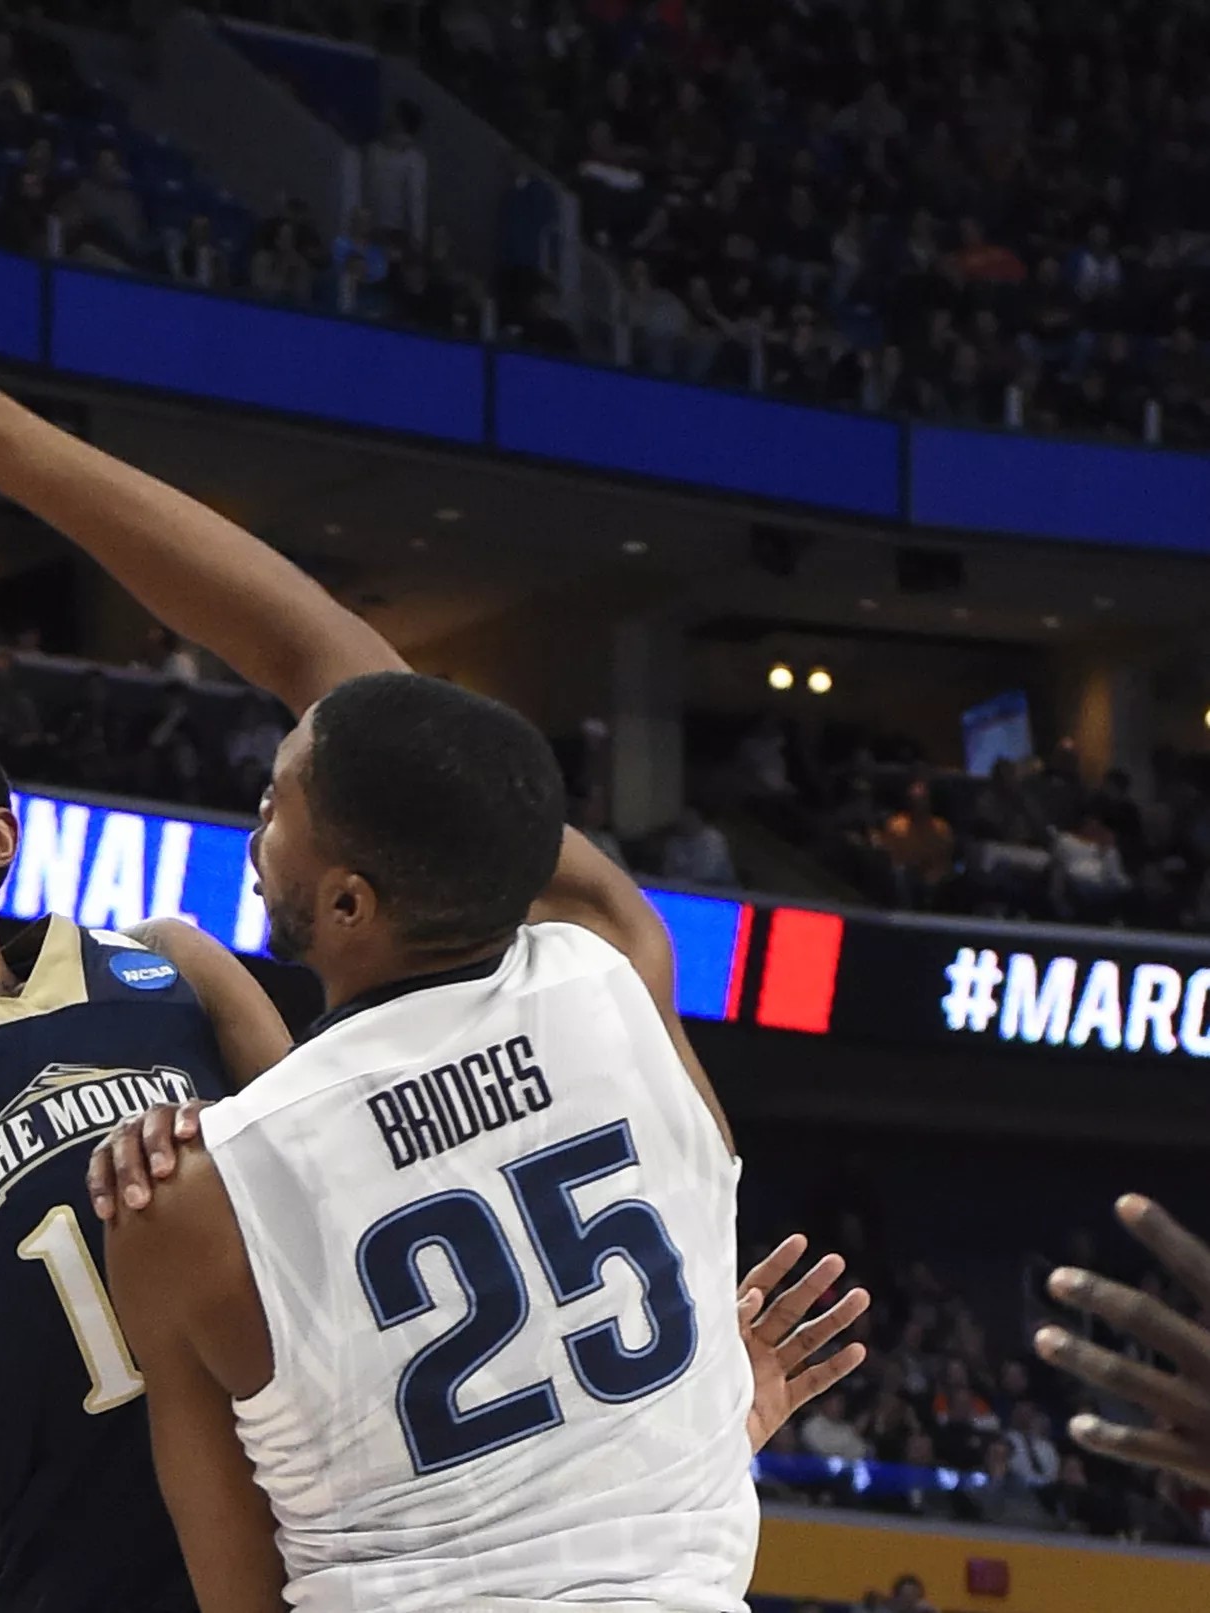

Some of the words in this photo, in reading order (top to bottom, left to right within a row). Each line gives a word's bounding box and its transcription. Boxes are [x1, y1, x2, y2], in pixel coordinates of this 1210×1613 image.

[41, 1070, 190, 1141] MOUNT
[367, 1034, 553, 1170] BRIDGES
[355, 1117, 698, 1476] 25
